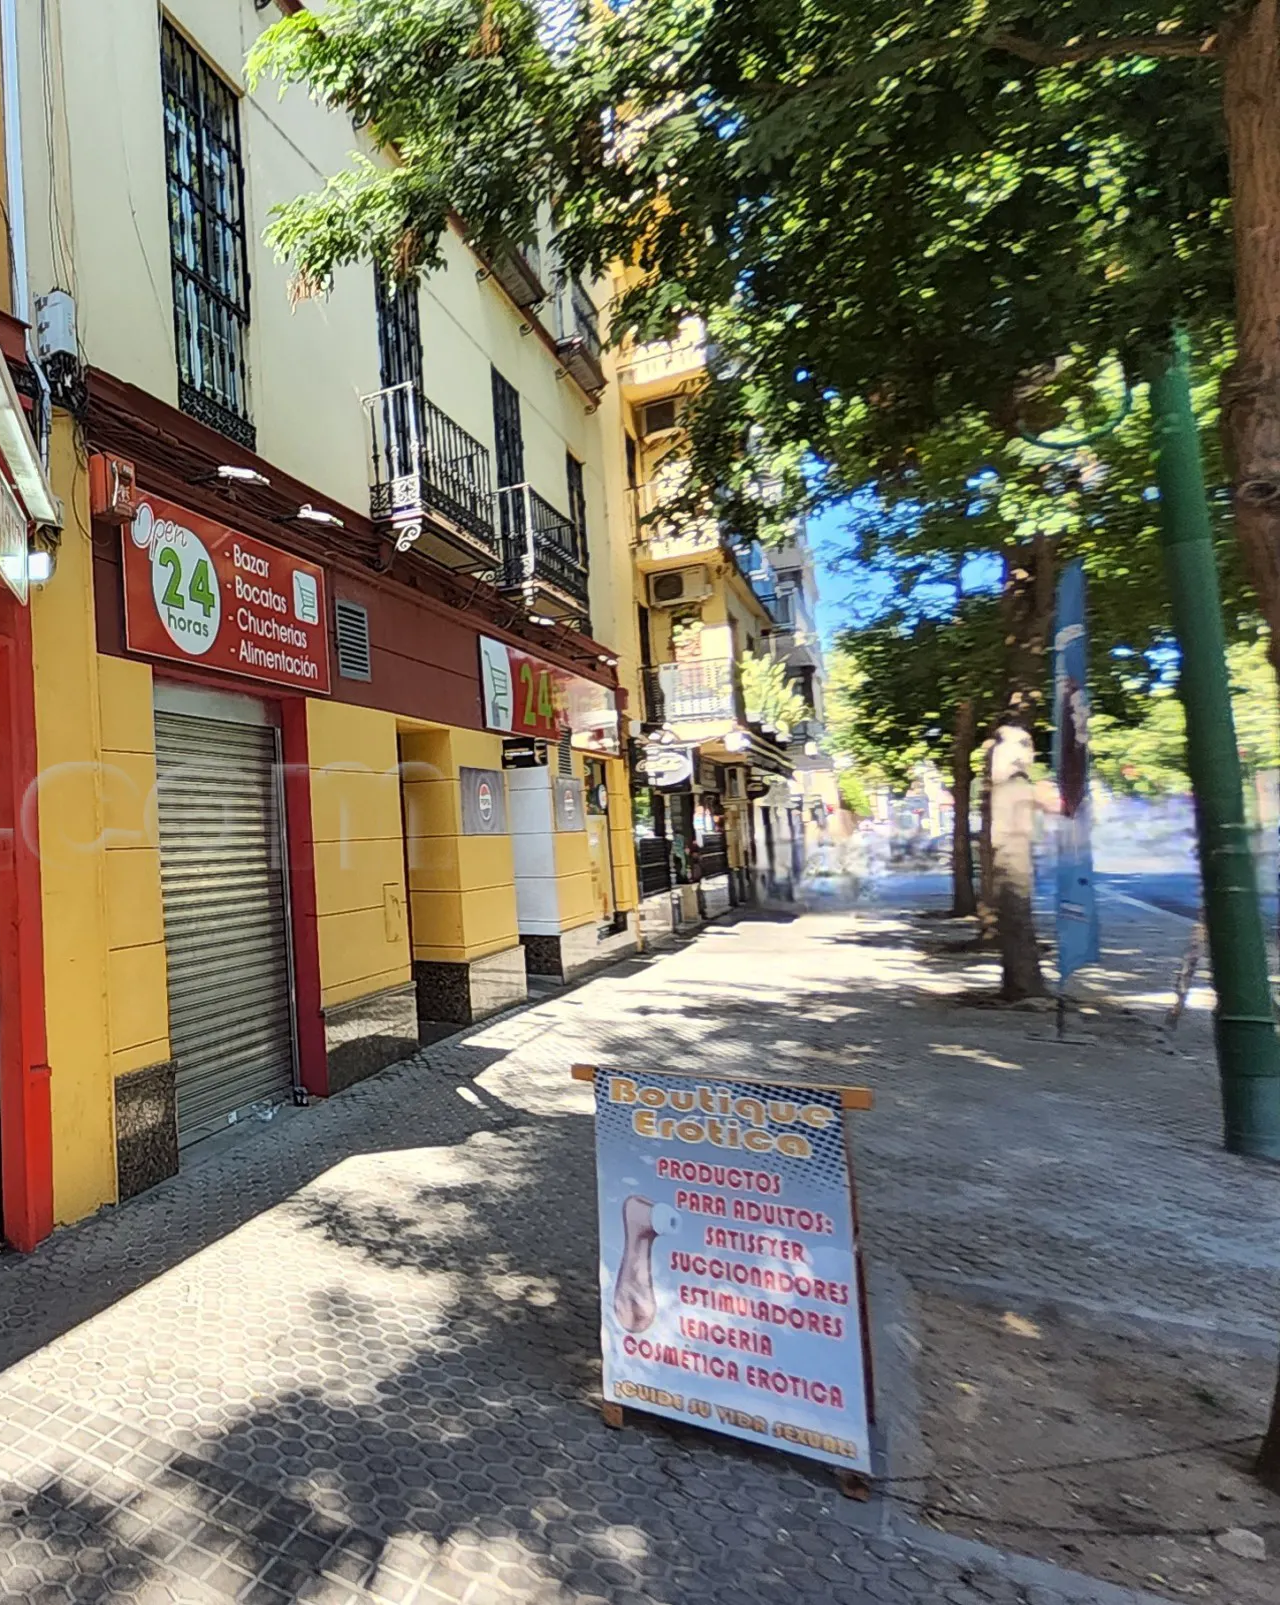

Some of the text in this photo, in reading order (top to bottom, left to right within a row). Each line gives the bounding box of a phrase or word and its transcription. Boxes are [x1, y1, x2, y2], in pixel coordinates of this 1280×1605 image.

[130, 502, 187, 562] Open
[159, 546, 215, 618] 24
[233, 544, 270, 578] Bazar
[235, 576, 287, 614] Bocatas
[168, 607, 209, 637] horas
[239, 638, 318, 680] Alimentación
[521, 663, 553, 729] 24
[608, 1076, 834, 1129] Boutique
[632, 1108, 812, 1158] Erótica
[657, 1157, 782, 1195] PRODUCTOS
[676, 1190, 834, 1235] PARA ADULTOS:
[705, 1226, 806, 1261] SATISFYER
[670, 1251, 850, 1306] SUCCIONADORES
[679, 1284, 844, 1338] ESTIMULADORES
[688, 1398, 712, 1418] SU
[715, 1404, 769, 1435] VIDA
